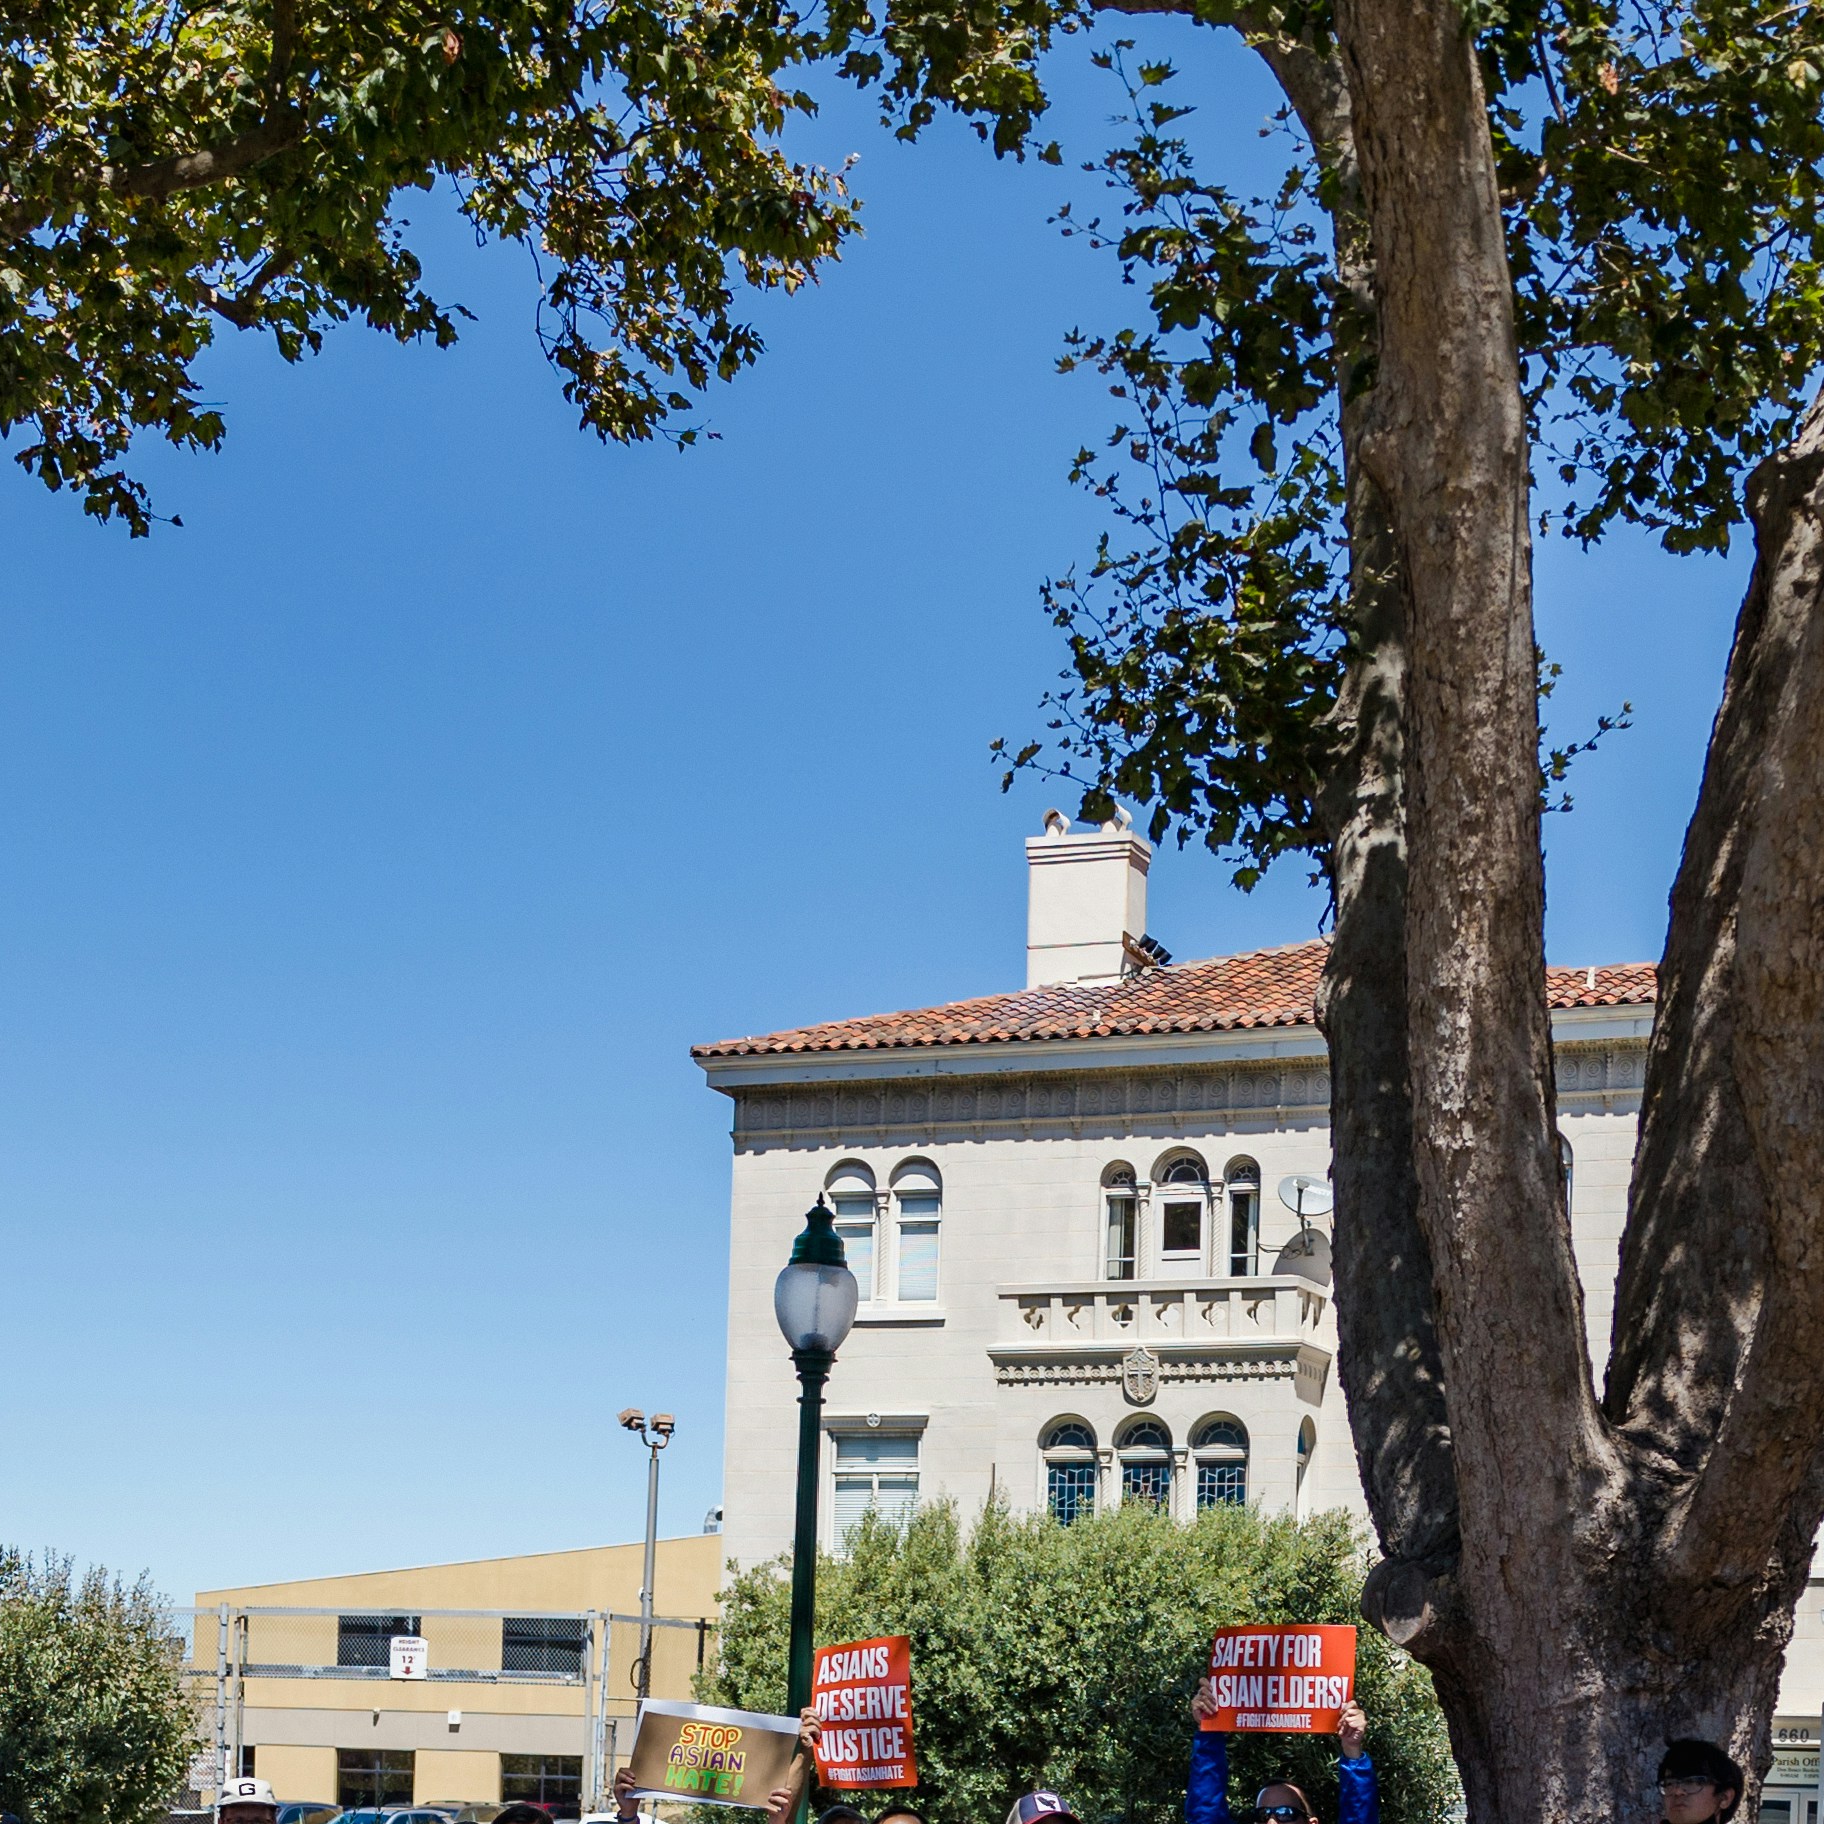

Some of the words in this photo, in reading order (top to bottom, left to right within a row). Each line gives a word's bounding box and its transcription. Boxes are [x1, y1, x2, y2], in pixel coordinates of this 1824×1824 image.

[817, 1646, 889, 1686] ASIANS
[1212, 1634, 1281, 1668] SAFETY
[1282, 1634, 1322, 1668] FOR
[816, 1685, 909, 1722] DESERVE
[1210, 1675, 1264, 1709] ASIAN
[1267, 1675, 1350, 1710] ELDERS!
[679, 1722, 742, 1750] STOP
[1236, 1713, 1312, 1729] #FIGHTASIANHATE
[1779, 1728, 1809, 1743] 660
[668, 1744, 746, 1774] ASIAN
[817, 1726, 907, 1763] JUSTICE
[828, 1765, 905, 1782] #FIGHTASIANHATE
[1771, 1755, 1799, 1766] Parish
[238, 1782, 256, 1796] G
[665, 1764, 745, 1797] HATE!
